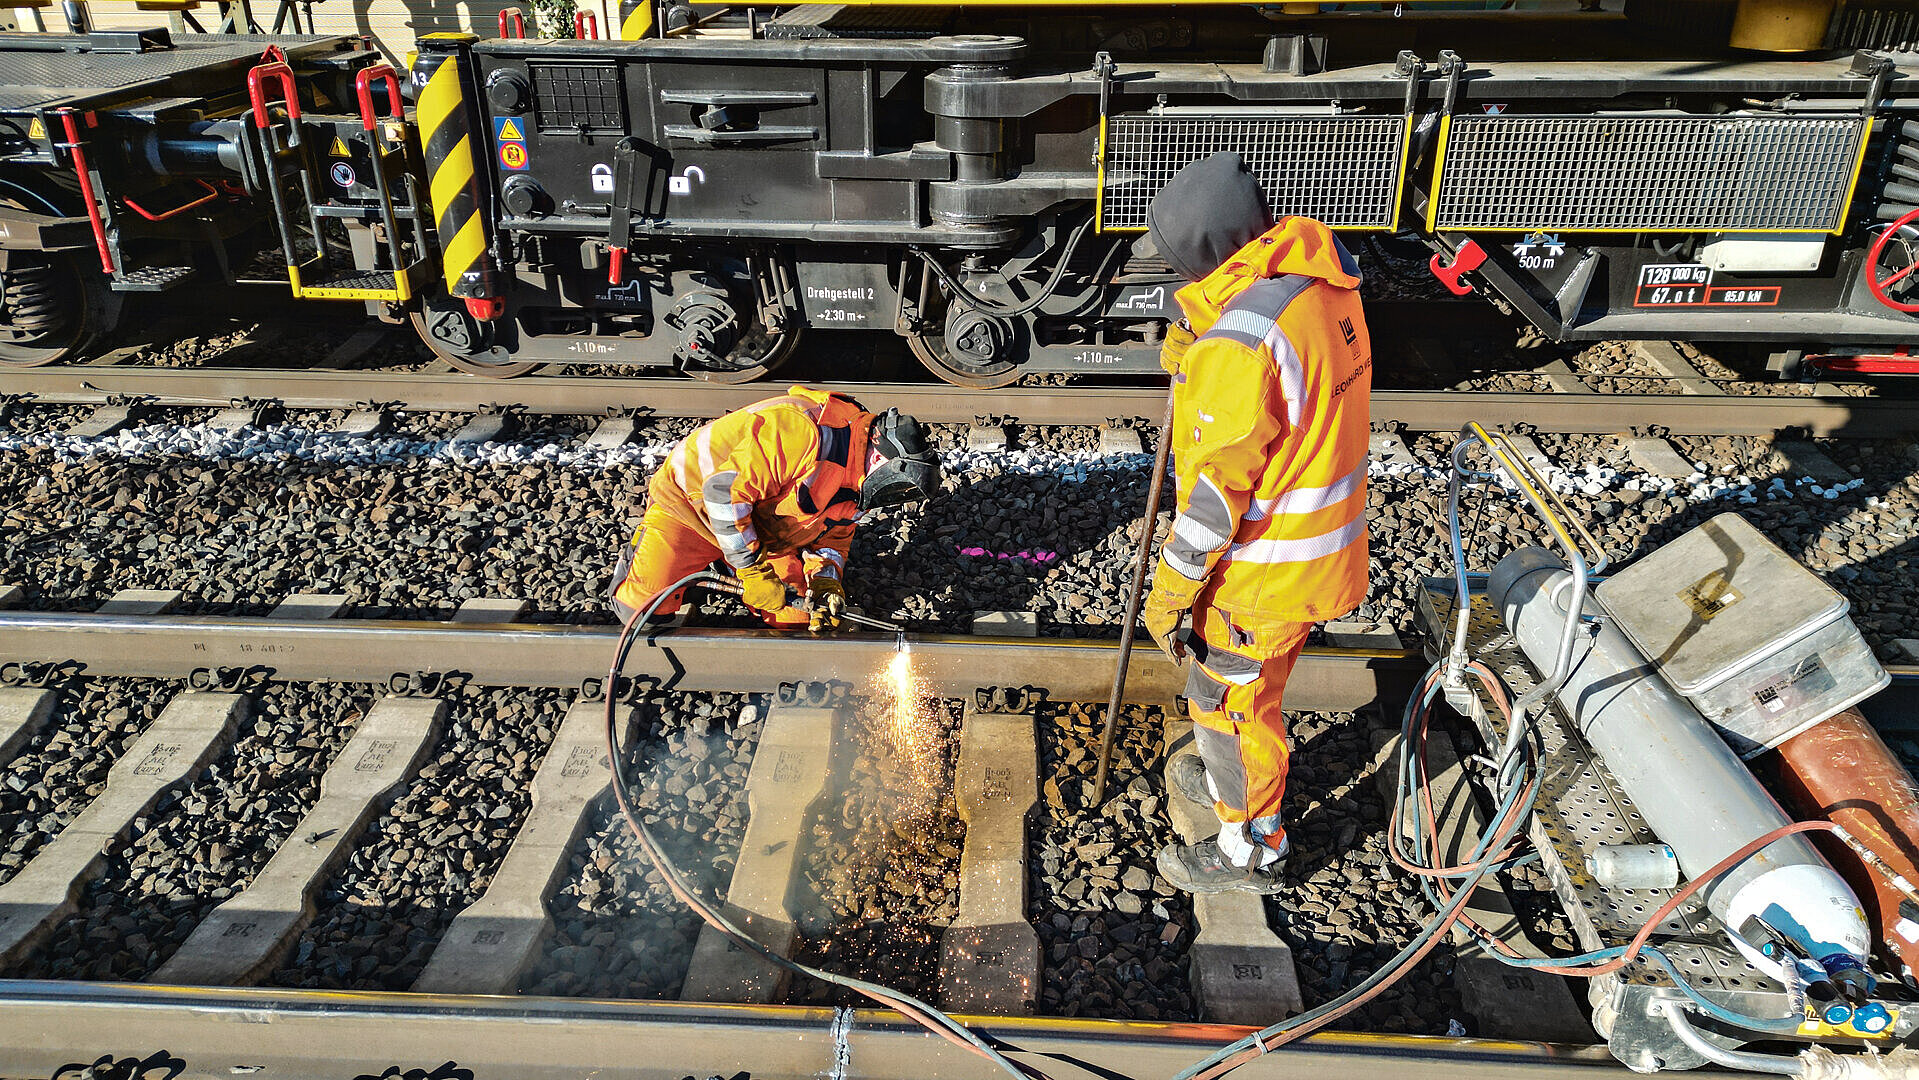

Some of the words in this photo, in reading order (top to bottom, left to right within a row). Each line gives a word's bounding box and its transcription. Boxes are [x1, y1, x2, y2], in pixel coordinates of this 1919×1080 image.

[1519, 255, 1541, 269] 500
[1542, 258, 1555, 269] m
[1647, 267, 1671, 285] 128
[1672, 267, 1691, 281] 000
[1692, 268, 1707, 283] kg
[979, 280, 986, 293] 6
[807, 286, 865, 302] Drehgestell
[867, 287, 874, 300] 2
[1687, 287, 1696, 303] t
[1747, 290, 1762, 302] kN
[846, 312, 856, 321] m
[575, 341, 596, 353] 1.10
[597, 344, 607, 353] m
[1104, 353, 1113, 364] m
